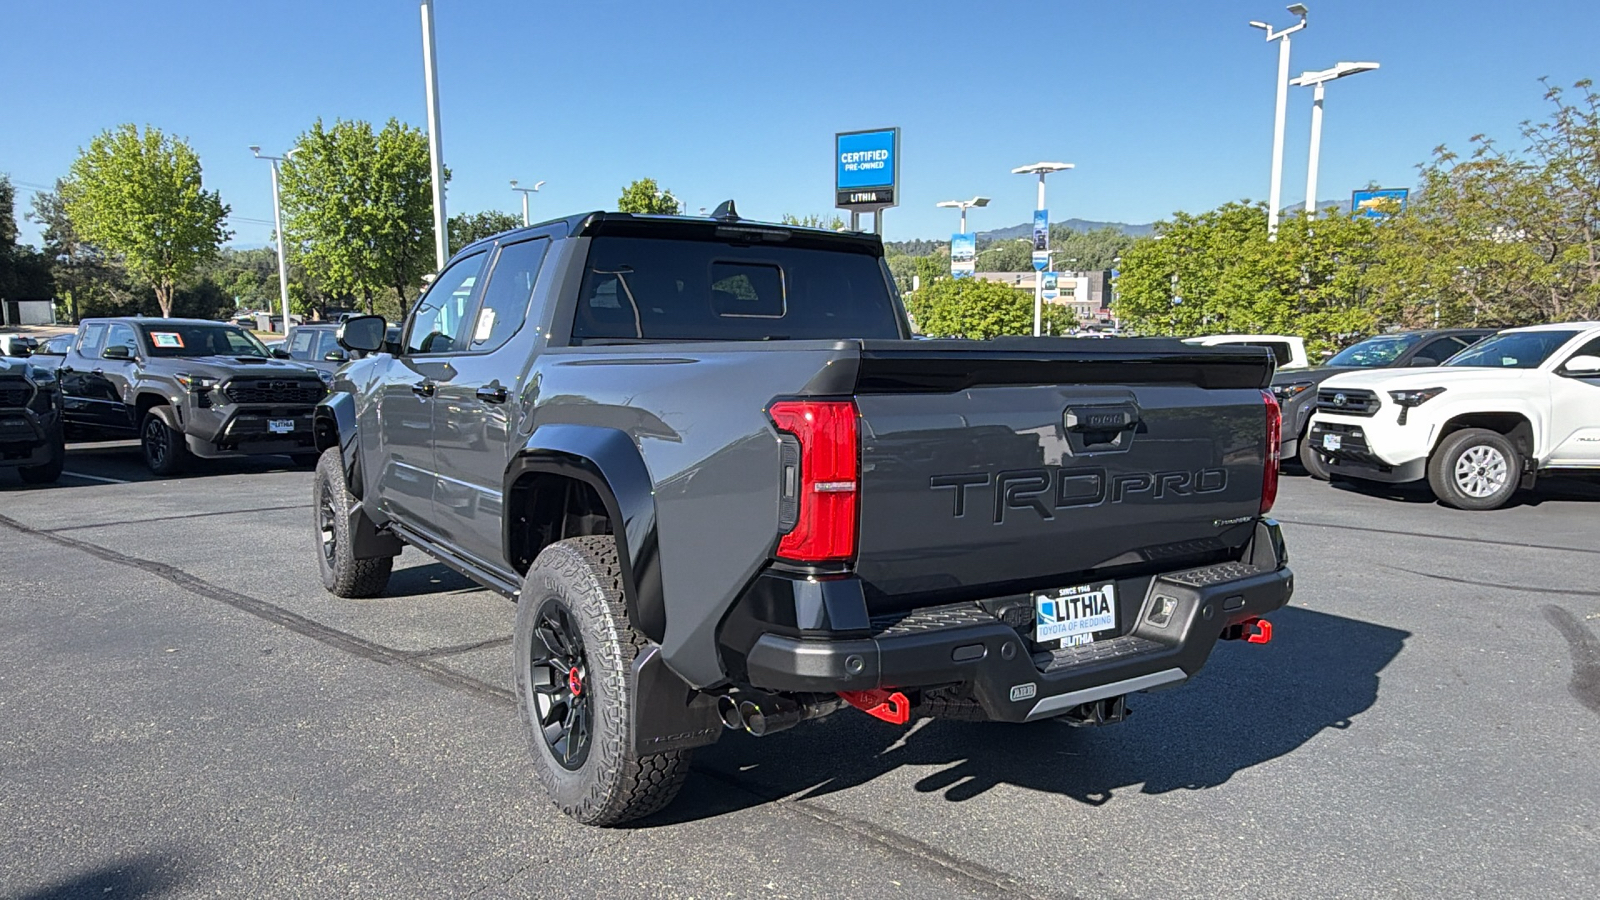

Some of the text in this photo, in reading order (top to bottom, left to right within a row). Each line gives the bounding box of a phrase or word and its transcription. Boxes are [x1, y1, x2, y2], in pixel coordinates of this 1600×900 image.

[841, 149, 888, 163] CERTIFIED
[845, 161, 884, 171] PRE-OWNED
[850, 192, 877, 203] LITHIA
[930, 466, 1228, 525] TRD PRO
[1055, 593, 1110, 622] LITHIA
[1040, 615, 1112, 637] TOYOTA OF REDDING
[1068, 632, 1094, 646] LITHIA
[1013, 686, 1034, 699] ARB
